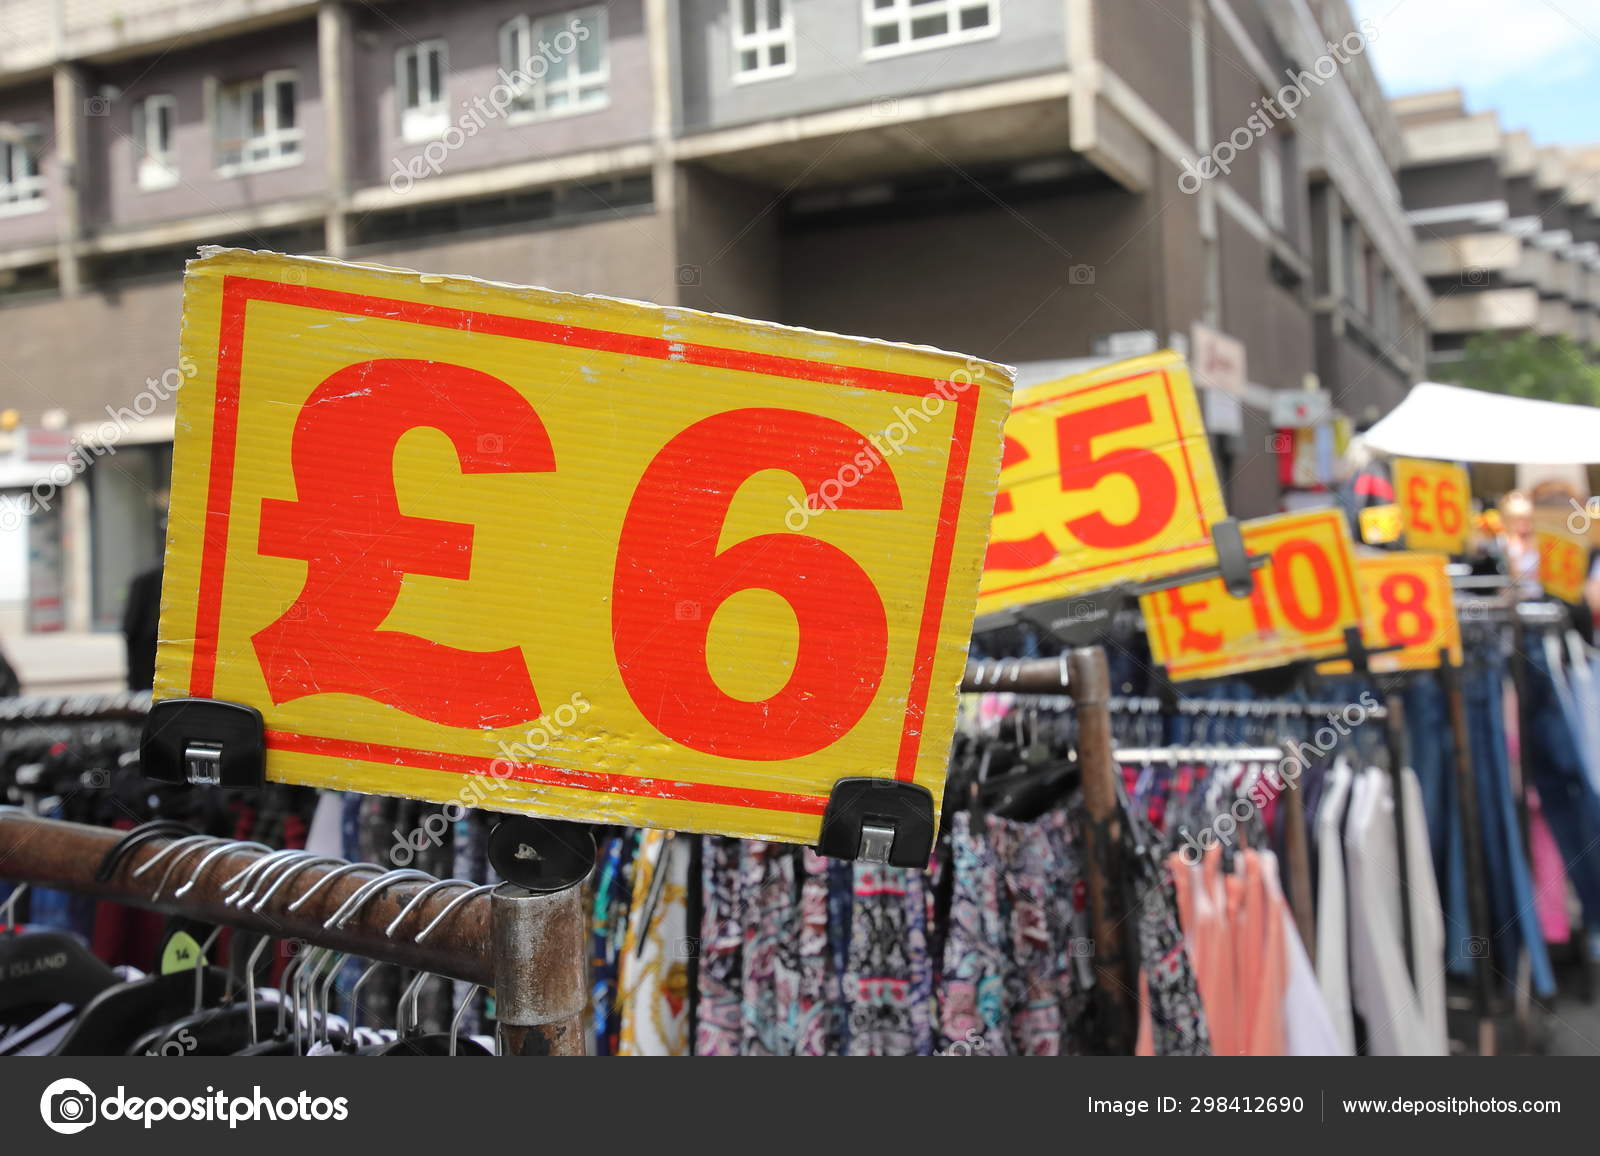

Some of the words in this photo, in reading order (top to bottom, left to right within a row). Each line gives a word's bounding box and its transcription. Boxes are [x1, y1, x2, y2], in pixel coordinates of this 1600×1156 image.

[1408, 475, 1463, 536] £6
[1165, 537, 1342, 653] £10
[10, 953, 67, 977] ISLAND
[175, 949, 190, 961] 14
